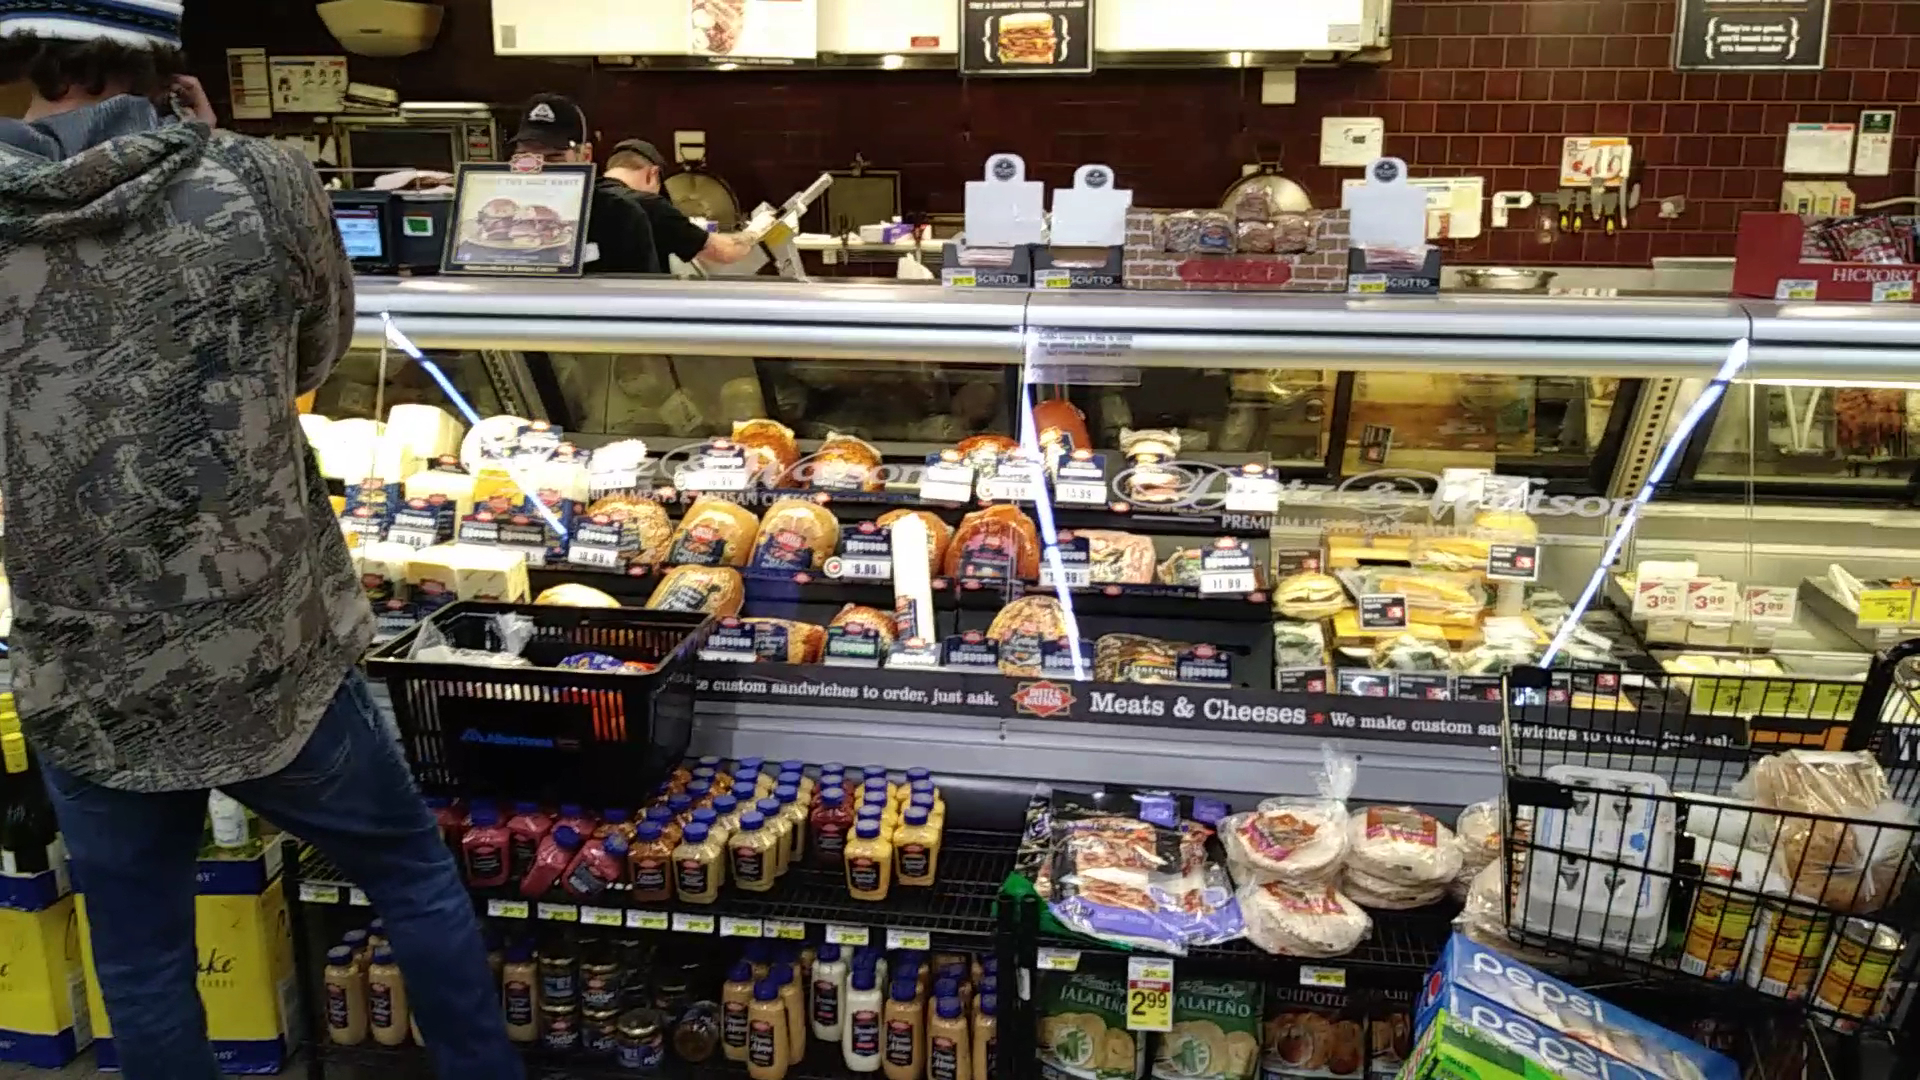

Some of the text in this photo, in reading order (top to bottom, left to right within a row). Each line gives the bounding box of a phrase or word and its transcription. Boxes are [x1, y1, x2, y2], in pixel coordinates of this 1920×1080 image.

[977, 274, 1019, 285] SCIUTTO
[1070, 275, 1114, 286] SCIUTTO
[1385, 277, 1430, 288] SCIUTTO
[1832, 268, 1912, 282] HICKORY
[713, 679, 767, 694] custom
[771, 681, 859, 699] sandwiches
[863, 685, 879, 700] to
[883, 687, 929, 704] order,
[931, 688, 963, 706] just
[967, 691, 999, 706] ask.
[1089, 691, 1307, 725] Meats & Cheeses
[1330, 711, 1356, 727] We
[1360, 715, 1406, 731] make
[1411, 719, 1473, 734] custom
[1464, 953, 1604, 1022] pepsi
[1176, 994, 1251, 1018] ALAPEÑO
